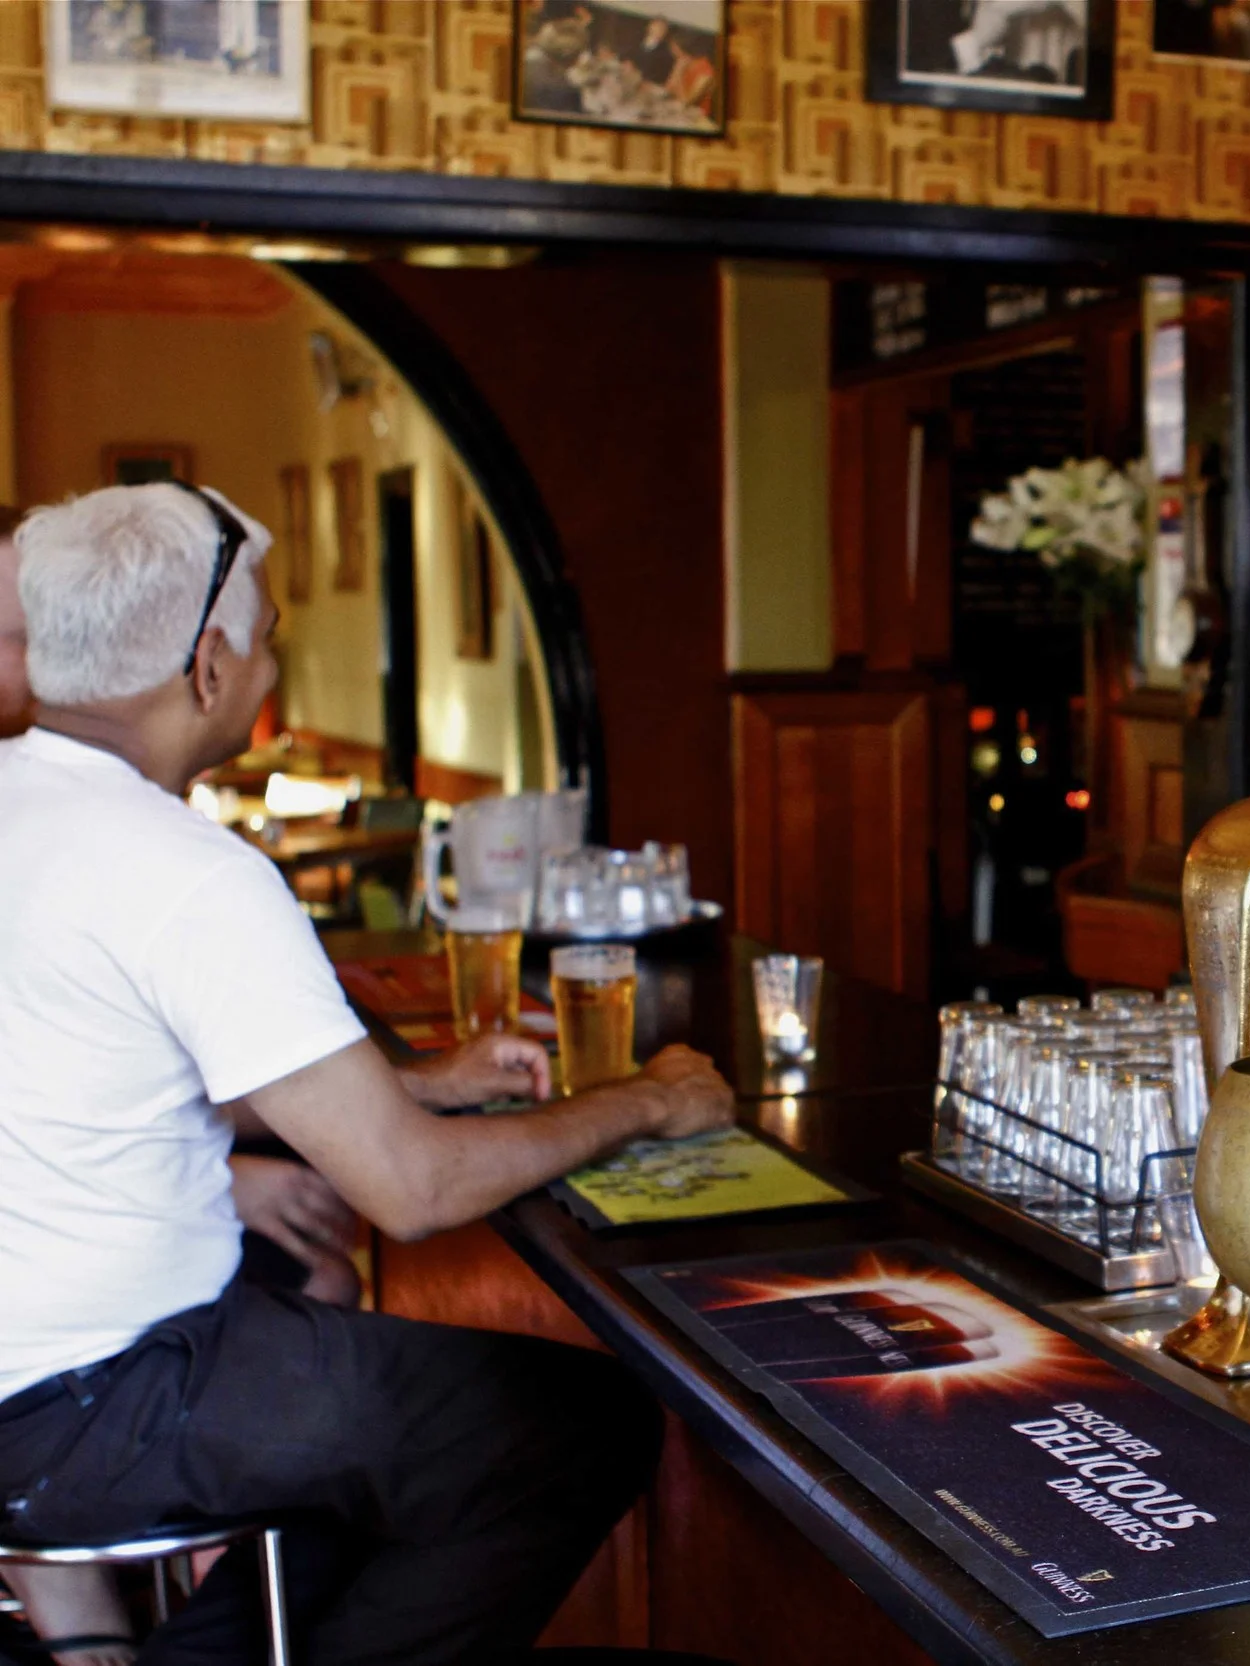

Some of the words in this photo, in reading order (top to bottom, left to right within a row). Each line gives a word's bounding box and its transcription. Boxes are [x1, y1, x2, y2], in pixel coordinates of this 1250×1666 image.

[1053, 1402, 1162, 1461] DISCOVER
[1010, 1418, 1217, 1530] DELICIOUS
[1046, 1477, 1175, 1552] DARKNESS
[1030, 1562, 1096, 1604] GUINNESS
